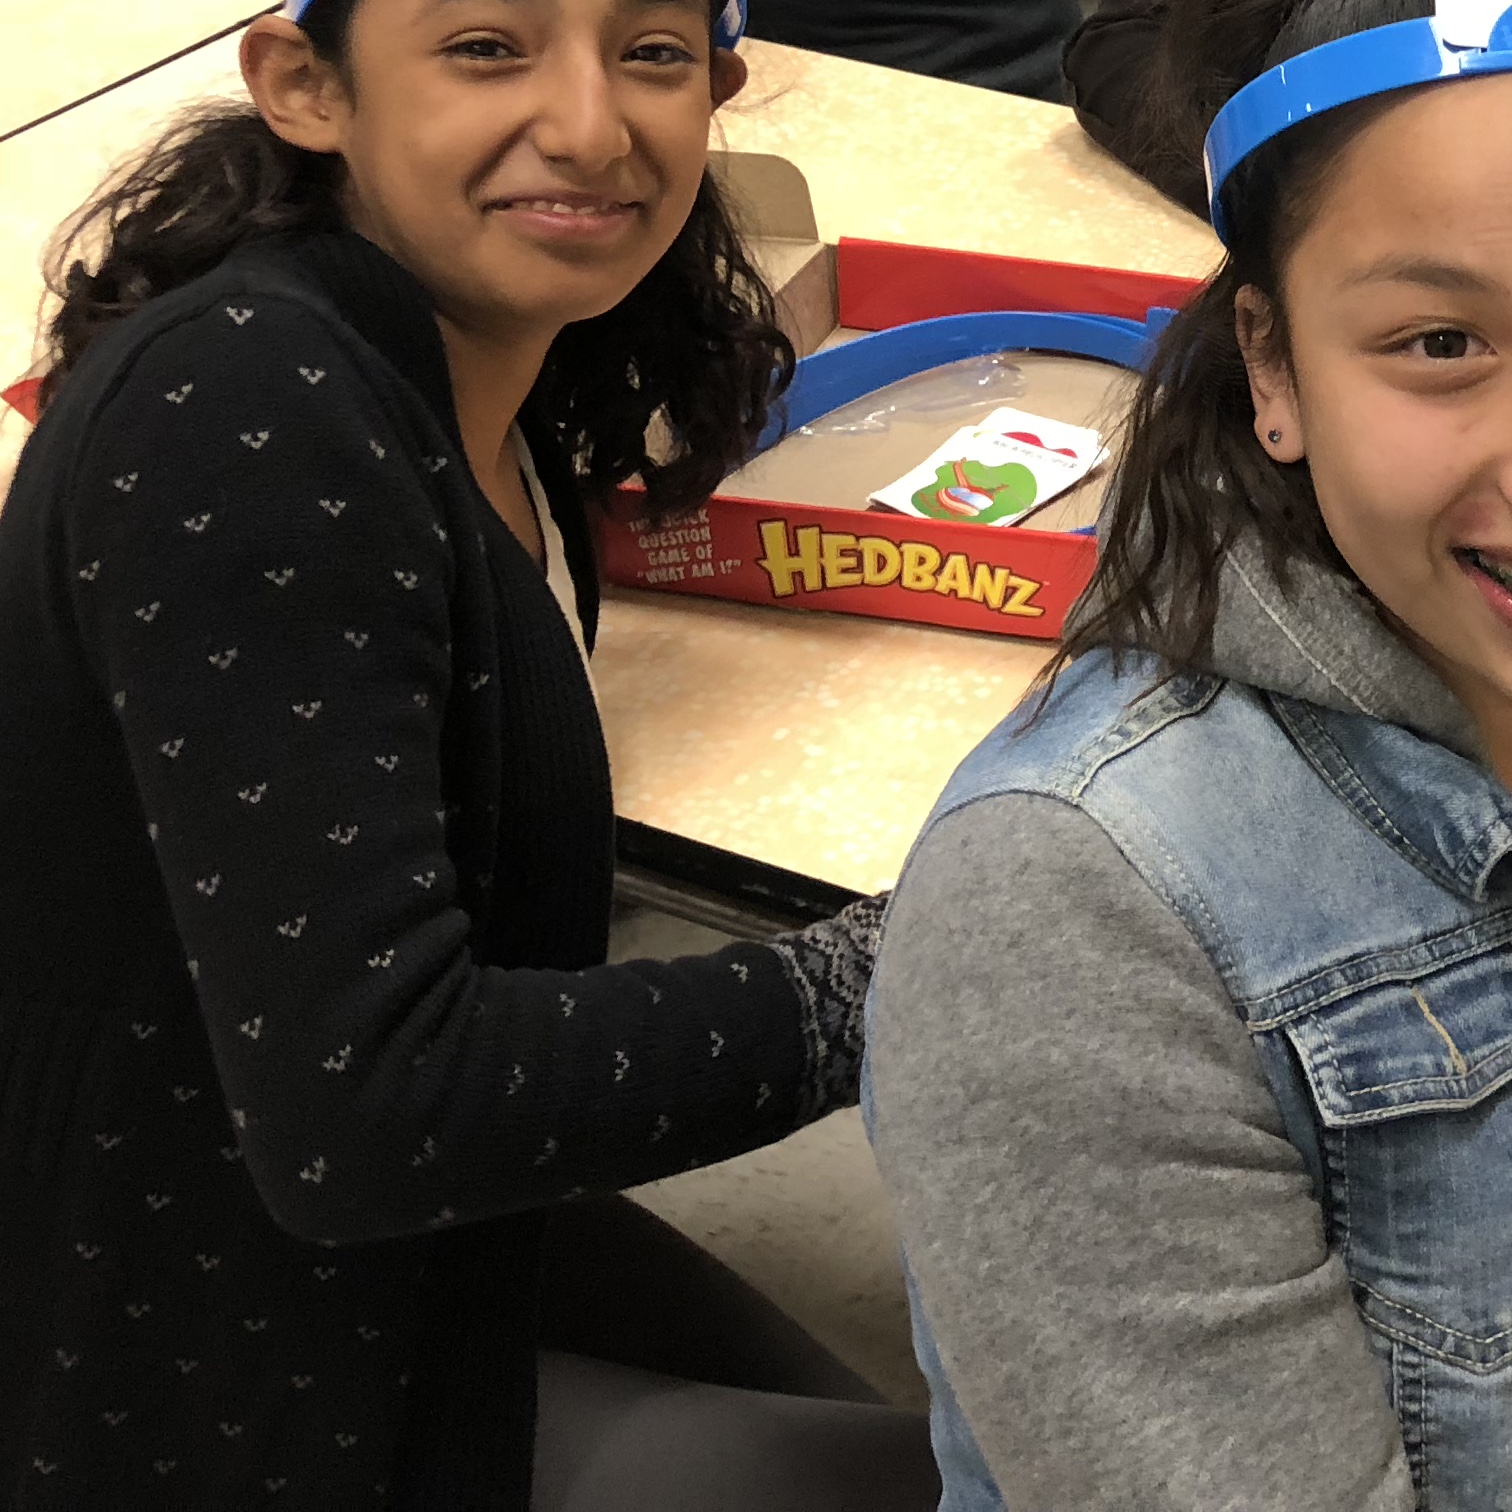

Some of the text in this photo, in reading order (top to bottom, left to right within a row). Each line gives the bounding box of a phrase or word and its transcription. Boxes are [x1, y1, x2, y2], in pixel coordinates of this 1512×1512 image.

[638, 526, 711, 548] QUESTION
[648, 543, 713, 566] GAME OF
[691, 561, 715, 578] AM
[756, 518, 1046, 617] HEDBANZ
